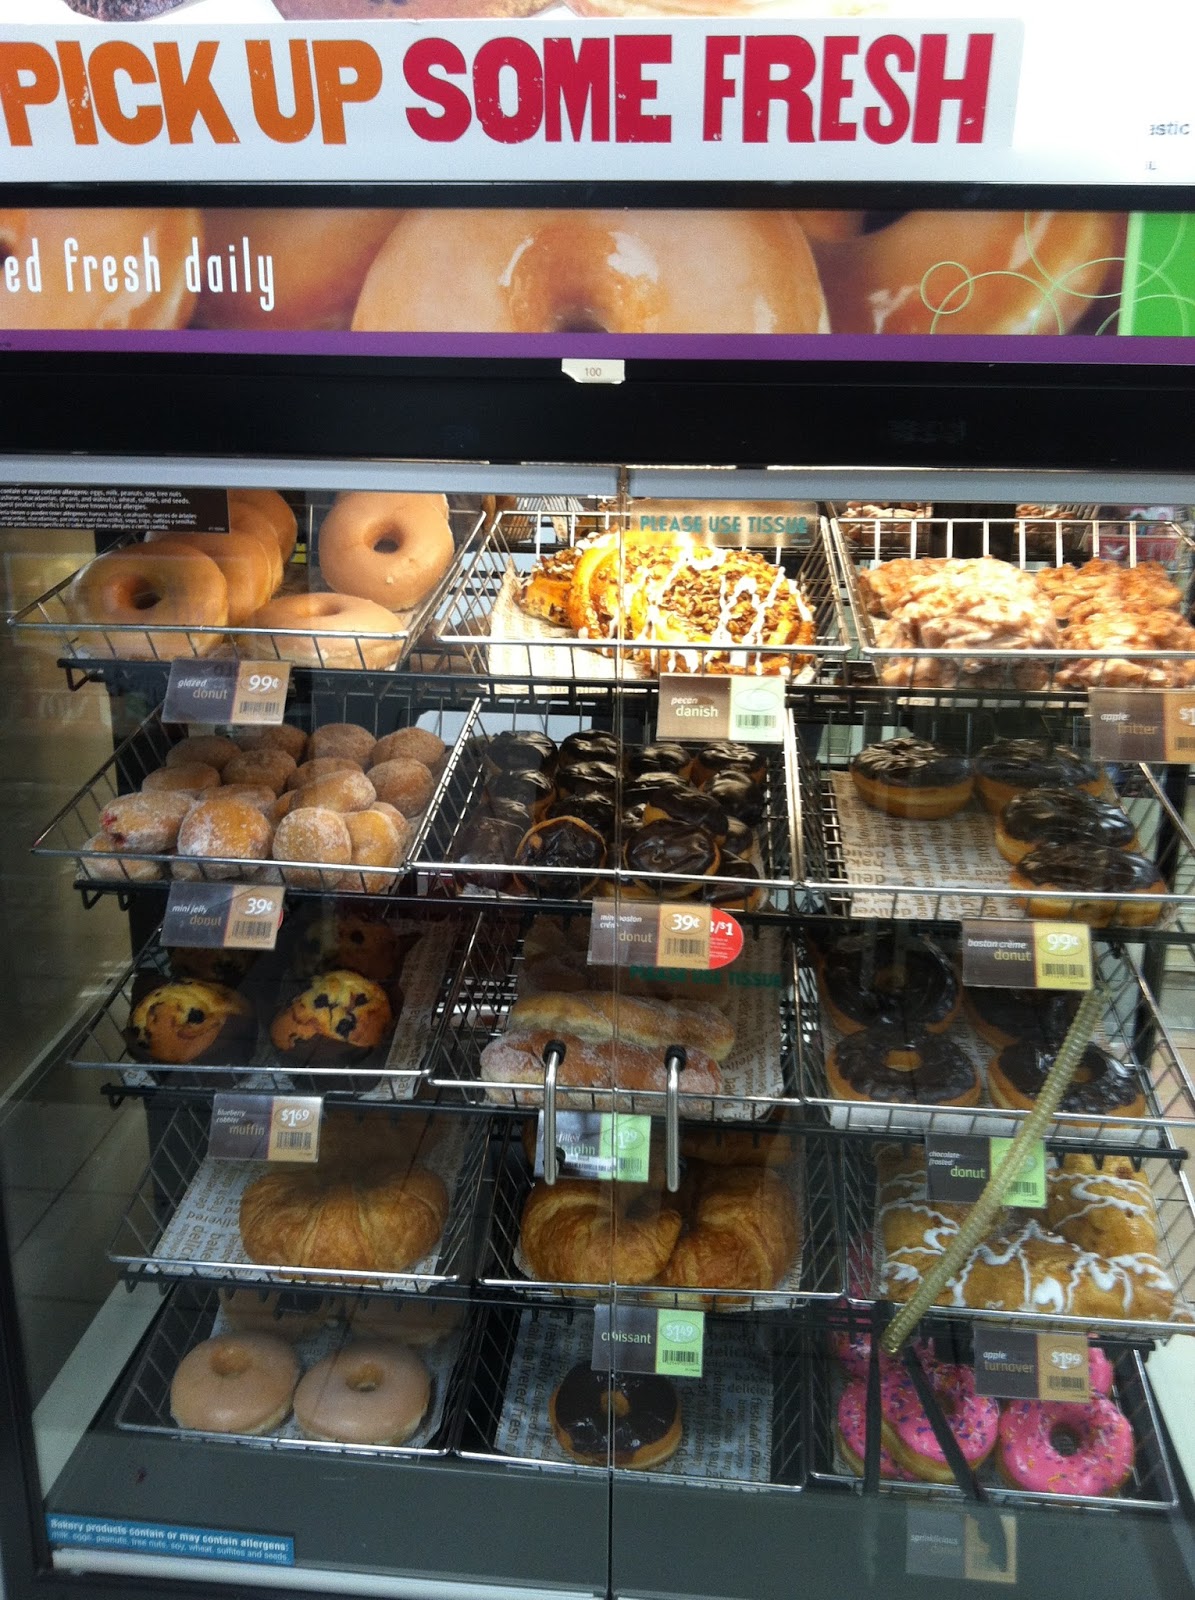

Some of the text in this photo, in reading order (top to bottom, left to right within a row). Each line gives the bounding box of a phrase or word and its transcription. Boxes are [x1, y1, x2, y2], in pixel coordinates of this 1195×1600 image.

[0, 33, 994, 146] PICK UP SOME FRESH
[5, 237, 275, 311] ed fresh daily
[585, 367, 602, 377] 100
[640, 515, 807, 534] PLEASE USE TISSUE
[192, 689, 227, 699] donut
[676, 705, 719, 717] danish
[189, 915, 222, 926] donut
[619, 930, 653, 943] donut
[993, 949, 1031, 962] donut
[229, 1123, 265, 1137] muffin
[950, 1165, 986, 1179] donut
[984, 1360, 1035, 1373] turnover
[167, 1531, 178, 1540] or
[180, 1532, 201, 1544] may
[203, 1535, 238, 1547] contain
